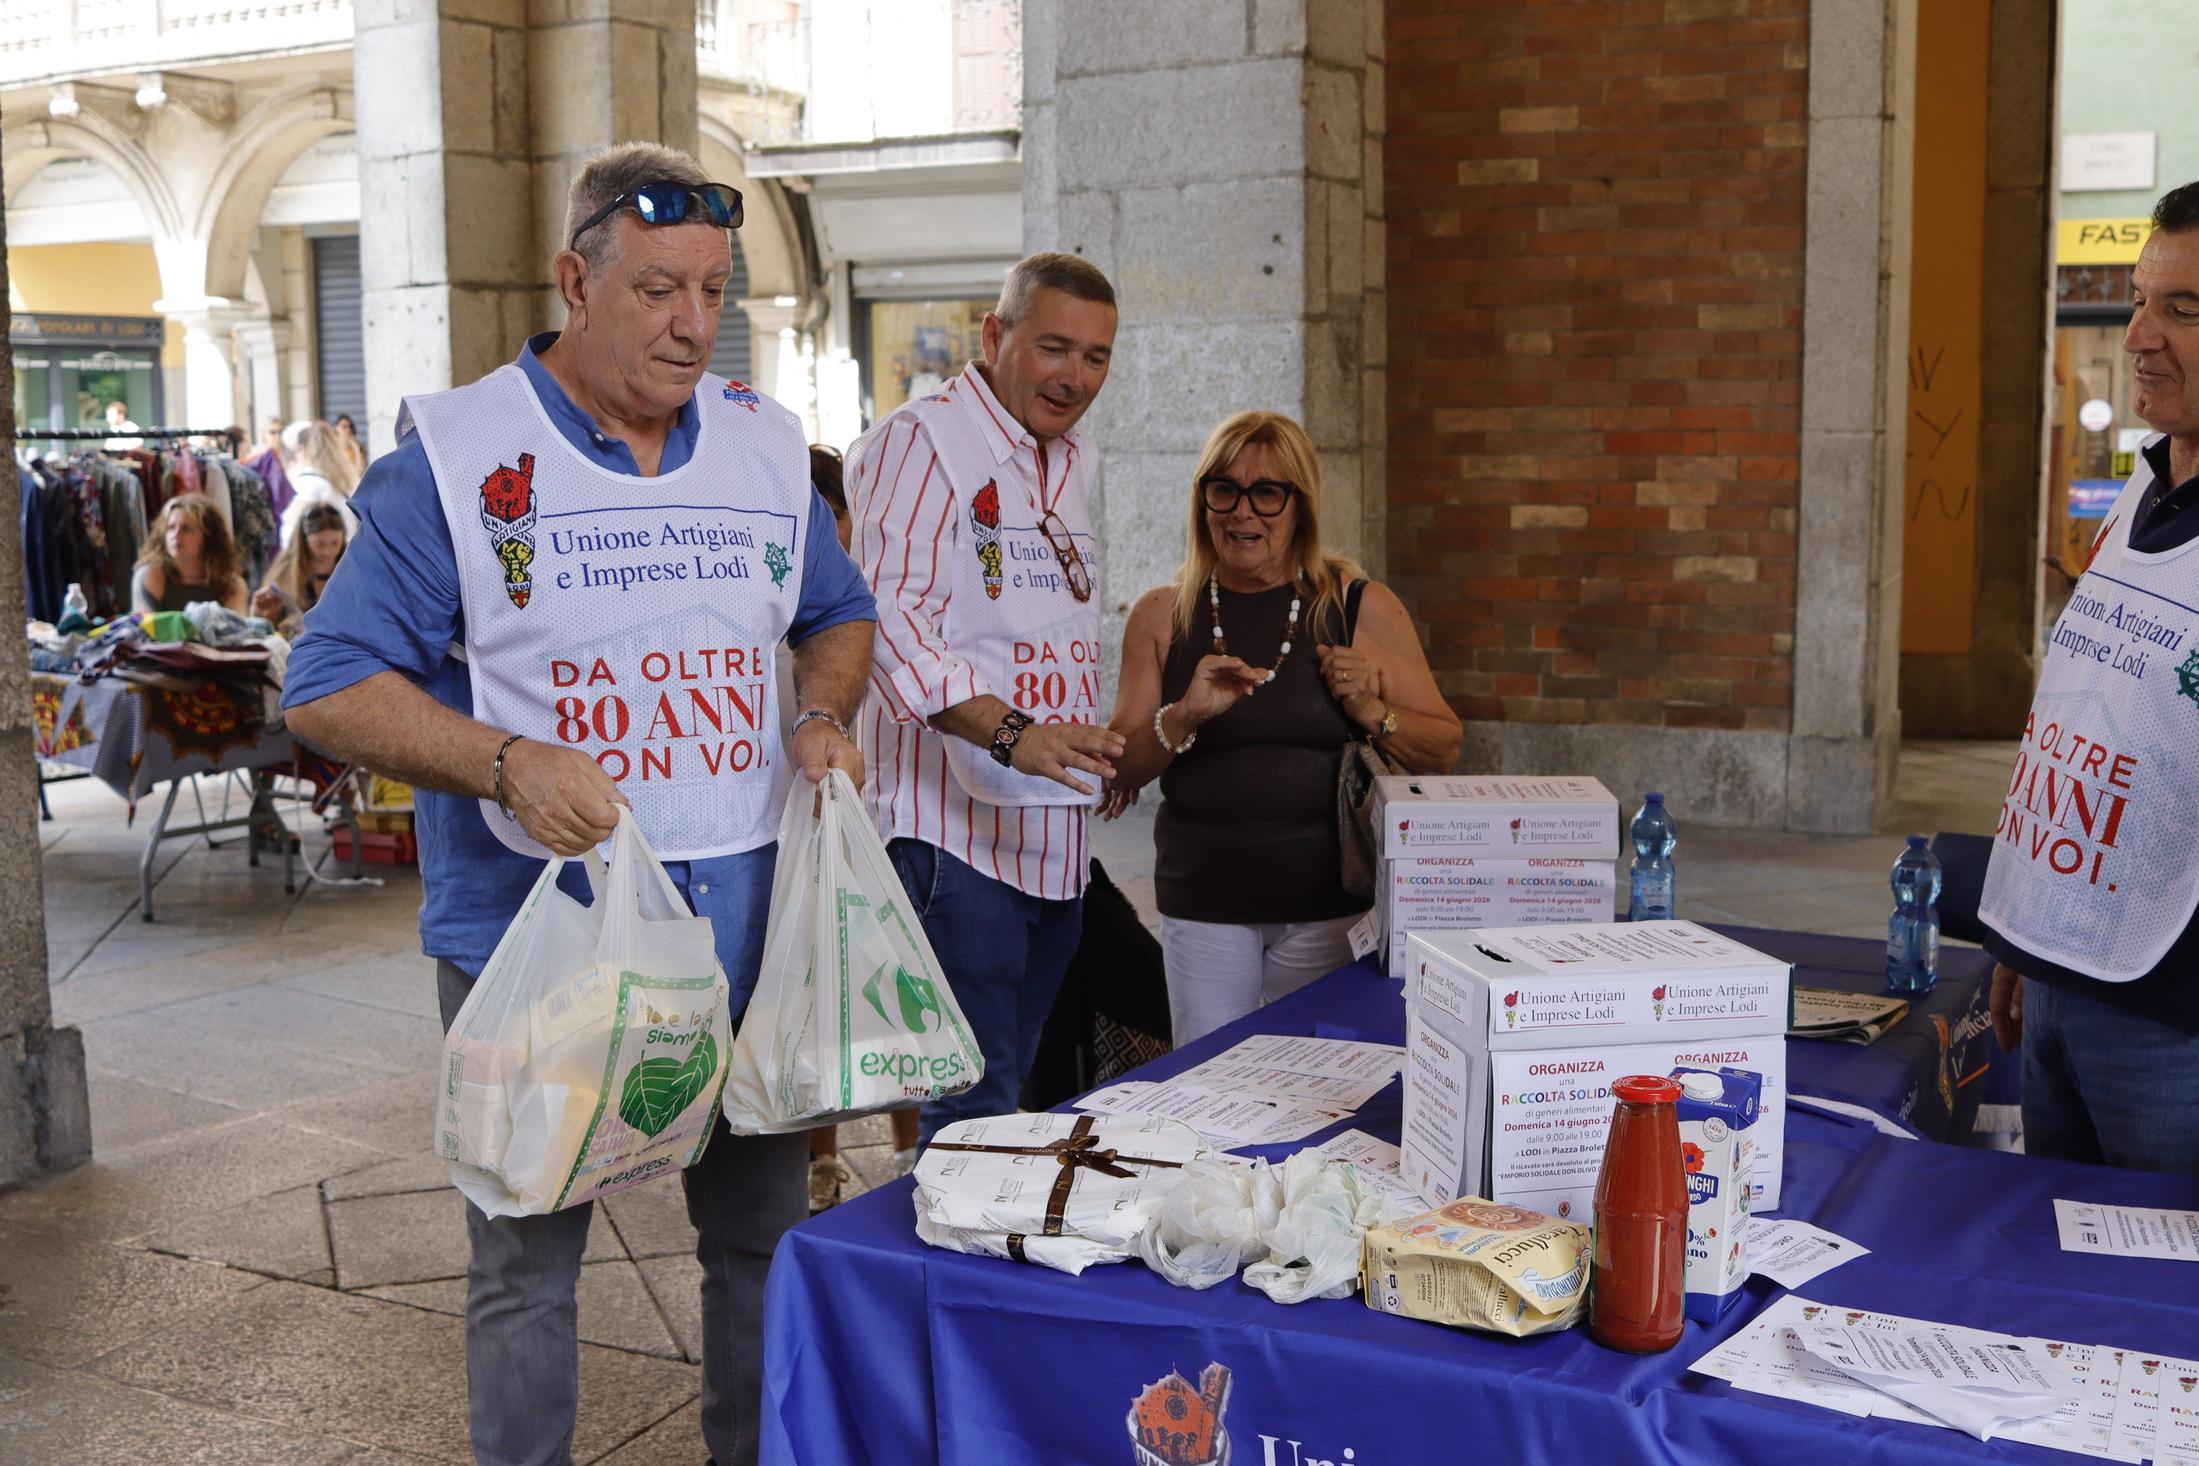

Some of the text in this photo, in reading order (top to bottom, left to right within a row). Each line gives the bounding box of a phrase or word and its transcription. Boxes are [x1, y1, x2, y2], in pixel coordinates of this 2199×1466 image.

[2079, 223, 2150, 245] FAS
[551, 521, 755, 555] Unione Artigiani
[557, 571, 573, 590] e
[580, 558, 688, 592] Imprese
[694, 555, 750, 580] Lodi
[1013, 574, 1023, 588] e
[2104, 602, 2188, 652] Artigiani
[1014, 641, 1058, 664] DA
[2111, 643, 2150, 680] Lodi
[551, 647, 763, 688] DA OLTRE
[1013, 671, 1066, 710] 80
[555, 683, 765, 744] 80 ANNI
[2024, 711, 2138, 790] A OLTRE
[596, 745, 671, 783] ON
[2017, 760, 2131, 849] ANNI
[1411, 820, 1490, 832] Unione Artigiani
[1522, 818, 1601, 831] Unione Artigiani
[1410, 831, 1482, 844] e Imprese Lodi
[1531, 831, 1568, 842] Imprese
[1571, 830, 1593, 840] Lodi
[1417, 857, 1474, 866] ORGANIZZA
[1528, 858, 1585, 868] ORGANIZZA
[2031, 822, 2117, 893] VOI.
[1397, 875, 1606, 888] RACCOLTA SOLIDALE RACCOLTA SOLIDALE
[1446, 897, 1472, 905] giugno
[1509, 896, 1545, 904] Domenica
[1557, 897, 1583, 906] giugno
[1521, 988, 1626, 1006] Unione Artigiani
[1669, 982, 1769, 999] Unione Artigiani
[1519, 1006, 1614, 1024] e Imprese Lodi
[1667, 999, 1758, 1017] e Imprese Lodi
[1421, 1031, 1450, 1061] ORGANIZZA
[1674, 1051, 1748, 1066] ORGANIZZA
[1412, 1049, 1460, 1095] RACCOLTA SOLIDALE
[1529, 1060, 1605, 1076] ORGANIZZA
[1559, 1078, 1575, 1086] una
[1502, 1087, 1614, 1105] RACCOLTA SOLIDA
[1525, 1104, 1606, 1120] di generi alimentari
[1504, 1116, 1612, 1132] Domenica 14 giugno 20
[1526, 1129, 1603, 1144] dalle 9.00 alle 19.00
[1521, 1148, 1541, 1157] LODI
[1543, 1147, 1550, 1155] in
[1551, 1145, 1578, 1155] Piazza
[1580, 1143, 1605, 1153] Brolet
[1515, 1161, 1540, 1170] ricavato
[1555, 1158, 1583, 1167] devoluto
[1530, 1168, 1561, 1178] SOLIDALE
[1562, 1167, 1576, 1176] DON
[1577, 1166, 1597, 1174] OLIVO
[1687, 1174, 1715, 1194] NGHI
[1493, 1225, 1584, 1268] Tarallucci
[1495, 1282, 1508, 1322] rallucci
